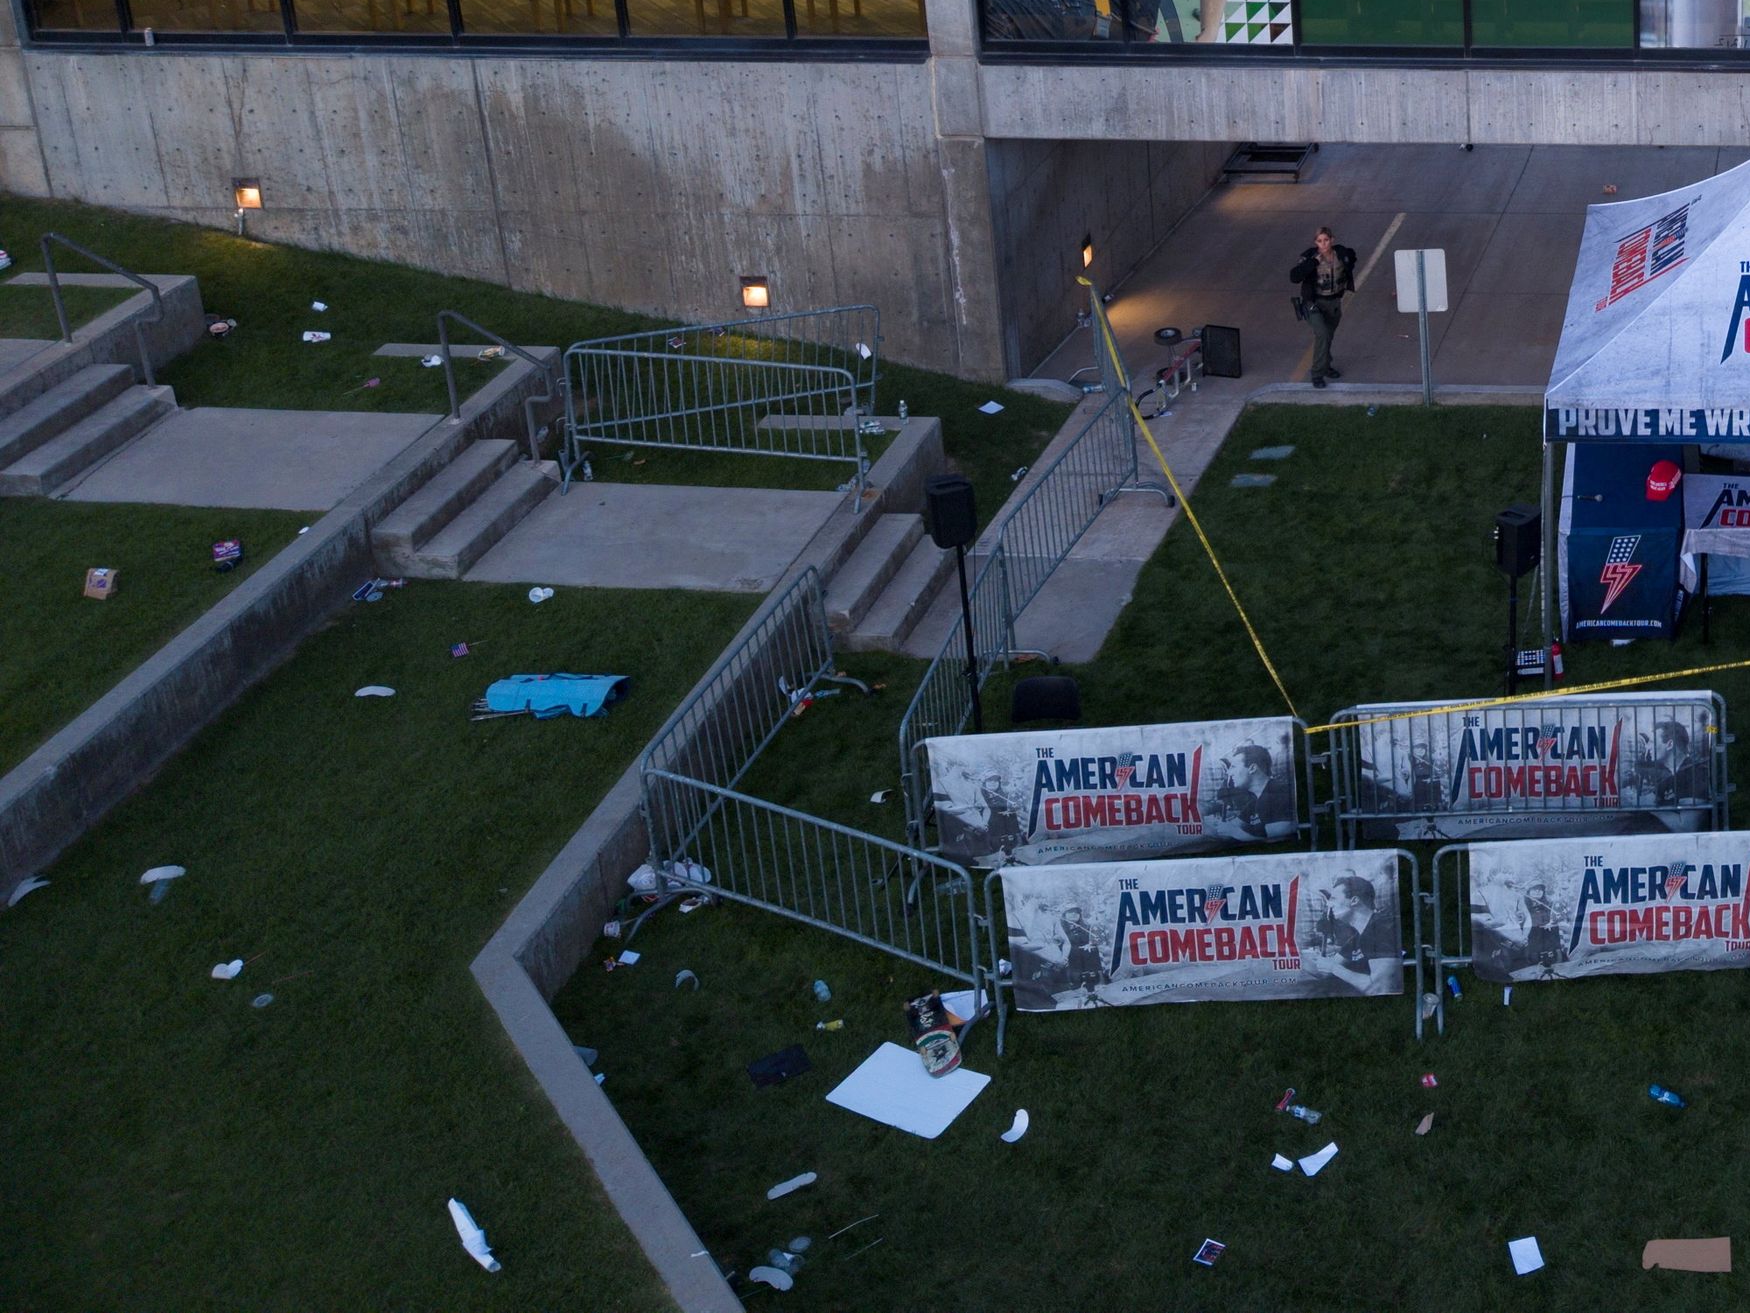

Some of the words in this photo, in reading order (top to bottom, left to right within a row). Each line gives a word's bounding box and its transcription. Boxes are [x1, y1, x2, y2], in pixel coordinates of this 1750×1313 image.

[1558, 408, 1651, 436] PROVE
[1659, 408, 1697, 436] ME
[1723, 482, 1739, 490] THE
[1463, 716, 1480, 727] THE
[1036, 747, 1054, 759] THE
[1469, 717, 1623, 799] COMEBACK
[1044, 744, 1202, 831] COMEBACK
[1176, 824, 1202, 836] TOUR
[1583, 855, 1604, 868] THE
[1118, 878, 1139, 890] THE
[1128, 874, 1301, 966] COMEBACK
[1272, 958, 1301, 971] TOUR
